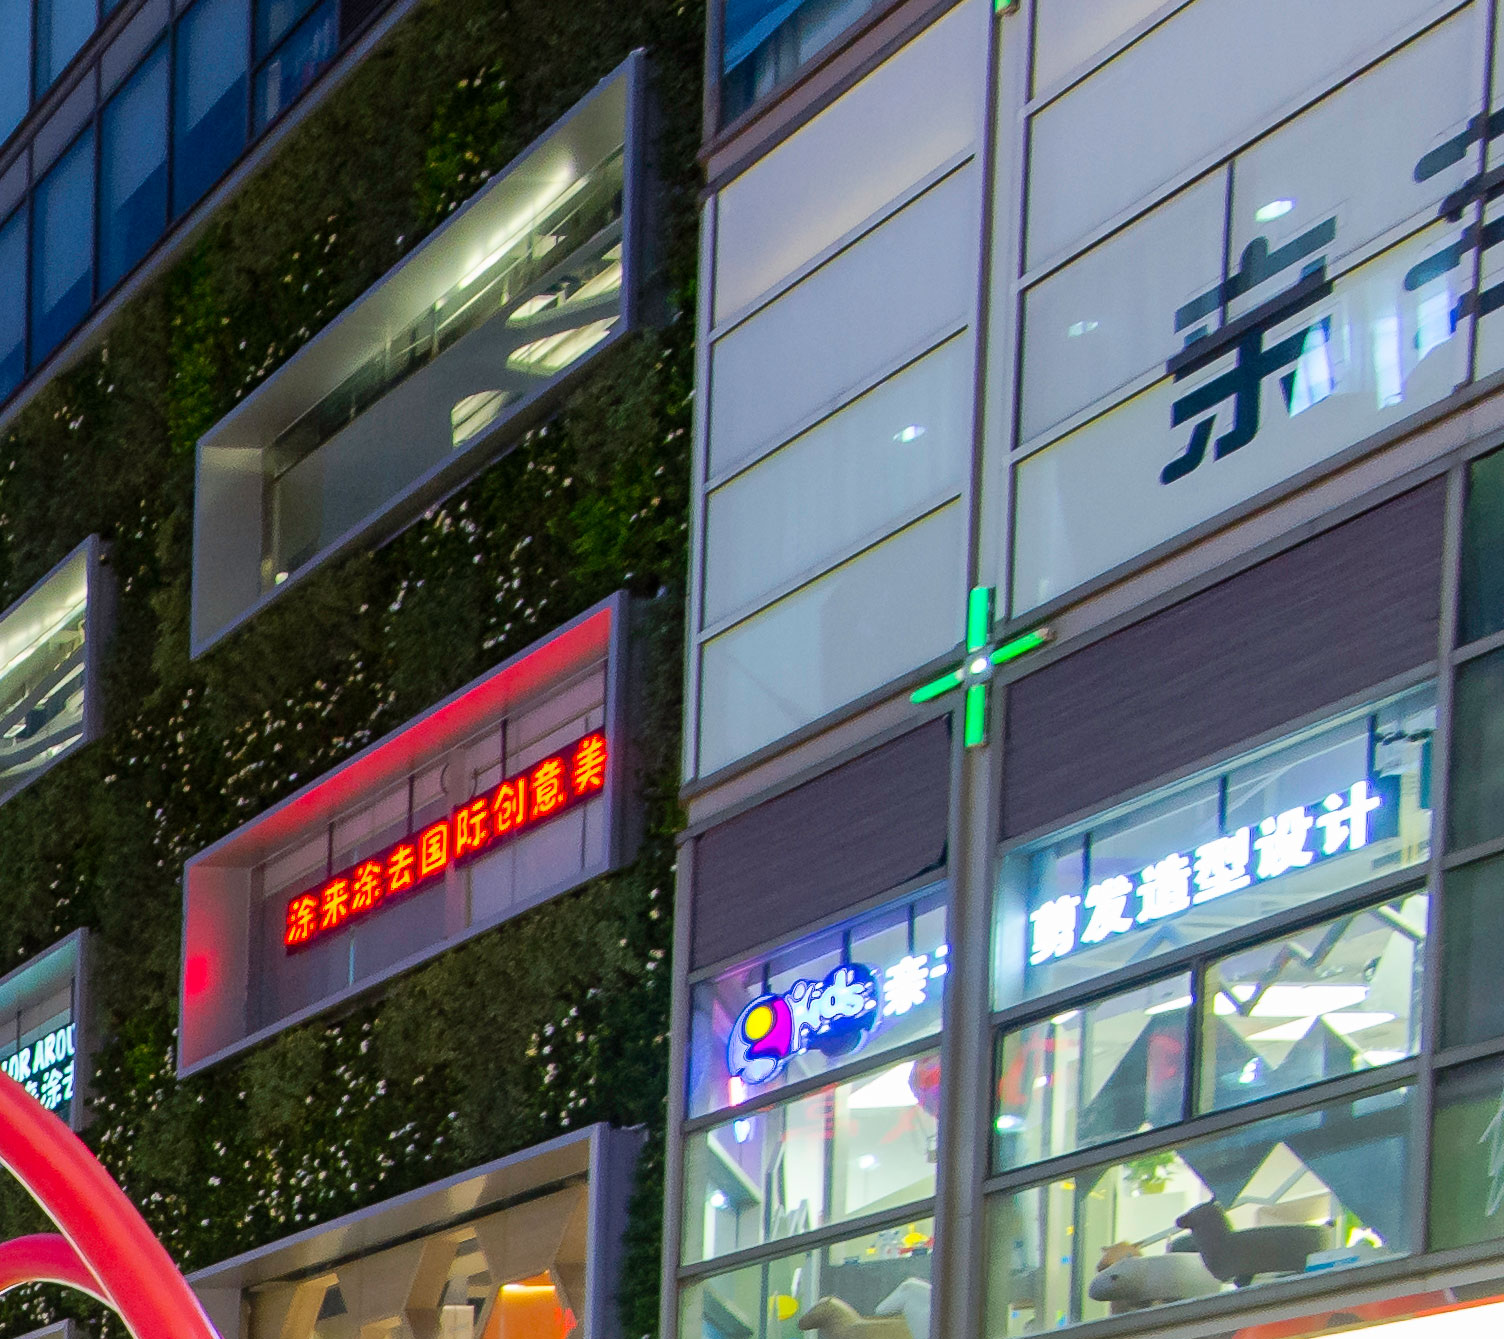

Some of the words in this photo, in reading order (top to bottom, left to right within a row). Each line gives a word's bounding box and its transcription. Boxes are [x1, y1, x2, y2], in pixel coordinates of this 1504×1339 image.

[284, 732, 608, 947] 涂来涂去国际创意美
[1029, 780, 1382, 966] 剪发造型设计
